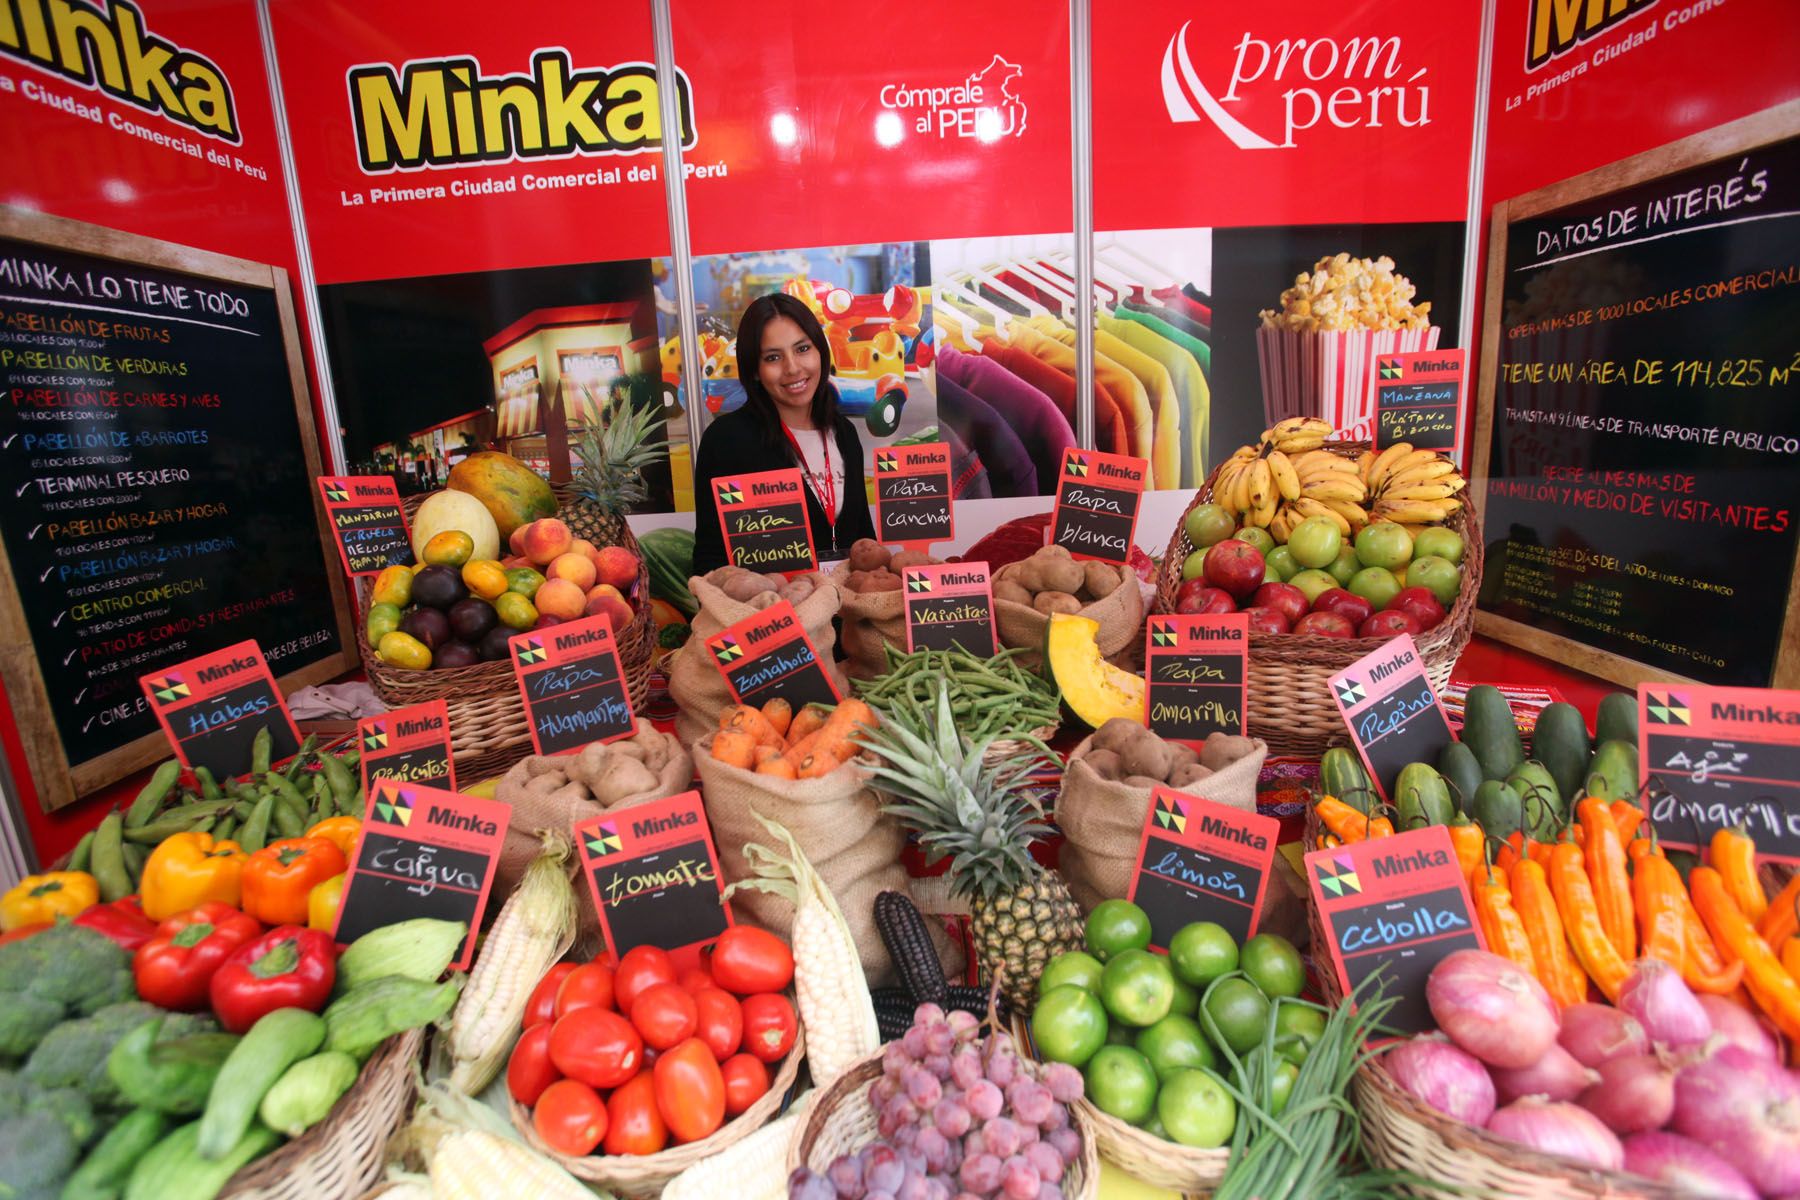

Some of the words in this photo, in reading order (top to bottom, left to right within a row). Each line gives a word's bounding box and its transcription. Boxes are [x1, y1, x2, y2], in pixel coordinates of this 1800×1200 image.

[1219, 31, 1404, 103] prom
[1505, 94, 1521, 112] La
[1527, 61, 1588, 101] Primera
[1592, 21, 1658, 67] Ciudad
[880, 78, 984, 112] Cómprale
[1280, 66, 1433, 149] perú
[349, 49, 696, 173] Minka
[916, 111, 932, 133] al
[21, 79, 103, 124] Ciudad
[108, 112, 202, 160] Comercial
[207, 149, 231, 169] del
[234, 157, 267, 181] Perú
[341, 190, 364, 207] La
[370, 184, 446, 203] Primera
[450, 174, 517, 197] Ciudad
[522, 167, 622, 191] Comercial
[627, 164, 658, 183] del
[682, 159, 728, 180] Perú
[1537, 216, 1603, 256] DATOS
[1607, 206, 1639, 238] DE
[1645, 157, 1768, 229] INTERÉS
[0, 257, 84, 297] MINKA
[86, 272, 122, 299] LO
[124, 277, 192, 310] TIENE
[195, 289, 250, 317] TODO
[1508, 318, 1549, 340] OPERAN
[1577, 310, 1593, 326] DE
[1626, 289, 1692, 317] LOCALES
[1695, 265, 1800, 302] COMERCIAL
[88, 319, 111, 338] DE
[113, 323, 171, 344] FRUTAS
[1, 348, 90, 371] PABELLÓN
[91, 354, 114, 373] DE
[116, 357, 188, 376] VERDURAS
[1413, 360, 1459, 373] Minka
[1502, 362, 1544, 384] TIENE
[1548, 362, 1574, 384] UN
[1577, 359, 1629, 387] ÁREA
[1633, 358, 1664, 385] DE
[11, 385, 99, 408] PABELLÓN
[99, 391, 120, 407] DE
[124, 392, 178, 408] CARNES
[191, 393, 222, 408] AVES
[1383, 391, 1451, 404] MANZANA
[1506, 407, 1556, 426] TRANSITAN
[1606, 416, 1624, 433] DE
[23, 426, 109, 450] PABELLÓN
[110, 431, 131, 447] DE
[135, 430, 209, 446] ABARROTES
[907, 453, 946, 465] Minka
[1098, 463, 1141, 480] Minka
[35, 473, 116, 495] TERMINAL
[116, 468, 190, 488] PESQUERO
[355, 485, 394, 496] Minka
[752, 481, 798, 496] Minka
[886, 480, 937, 496] Papa
[1605, 470, 1636, 488] MES
[1673, 473, 1696, 495] DE
[1068, 490, 1121, 513] Papa
[1562, 488, 1570, 505] Y
[1573, 487, 1627, 512] MEDIO
[1630, 492, 1656, 517] DE
[1660, 496, 1790, 534] VISITANTES
[47, 511, 128, 540] PABELLÓN
[129, 509, 174, 529] BAZAR
[176, 508, 185, 522] Y
[186, 502, 229, 520] HOGAR
[736, 515, 794, 533] Papa
[1059, 523, 1126, 552] blanca
[59, 550, 139, 582] PABELLÓN
[194, 536, 236, 554] HOGAR
[941, 573, 985, 586] Minka
[1692, 578, 1734, 597] DOMINGO
[70, 595, 133, 622] CENTRO
[134, 577, 207, 606] COMERCIAL
[914, 604, 988, 625] Vainitas
[127, 630, 146, 649] DE
[149, 615, 206, 642] COMIDAS
[555, 628, 608, 651] Minka
[745, 615, 794, 645] Minka
[1189, 626, 1242, 641] Minka
[196, 656, 258, 684] Minka
[1158, 662, 1226, 684] Papa
[1369, 651, 1415, 684] Minka
[534, 669, 603, 696] Papa
[189, 696, 270, 733] Habas
[396, 716, 443, 738] Minka
[1711, 702, 1800, 725] Minka
[427, 805, 498, 836] Minka
[632, 810, 698, 839] Minka
[1200, 815, 1268, 851] Minka
[1372, 849, 1450, 879] Minka
